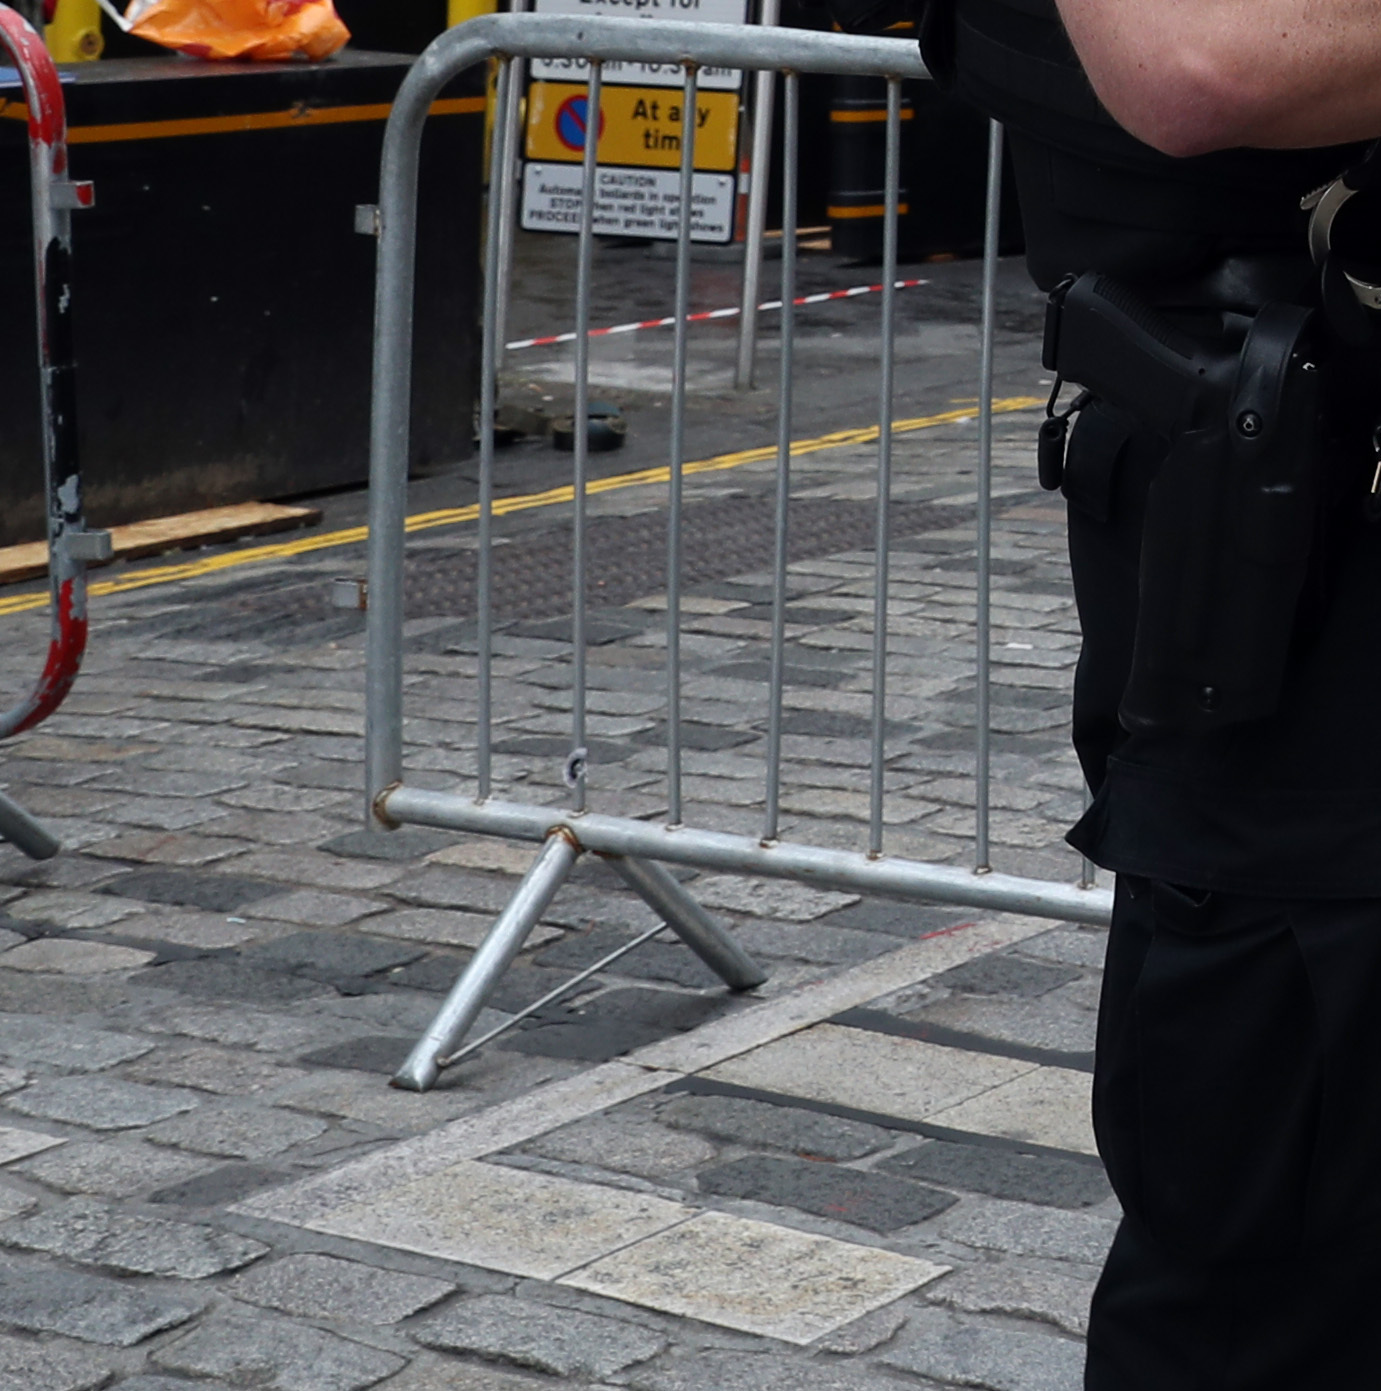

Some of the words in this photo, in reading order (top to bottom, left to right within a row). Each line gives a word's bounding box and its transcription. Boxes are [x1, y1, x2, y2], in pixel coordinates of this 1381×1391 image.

[632, 99, 660, 122] At
[669, 106, 711, 128] ay
[644, 129, 682, 151] tim
[601, 174, 657, 188] CAUTION
[529, 210, 580, 224] PROCEE
